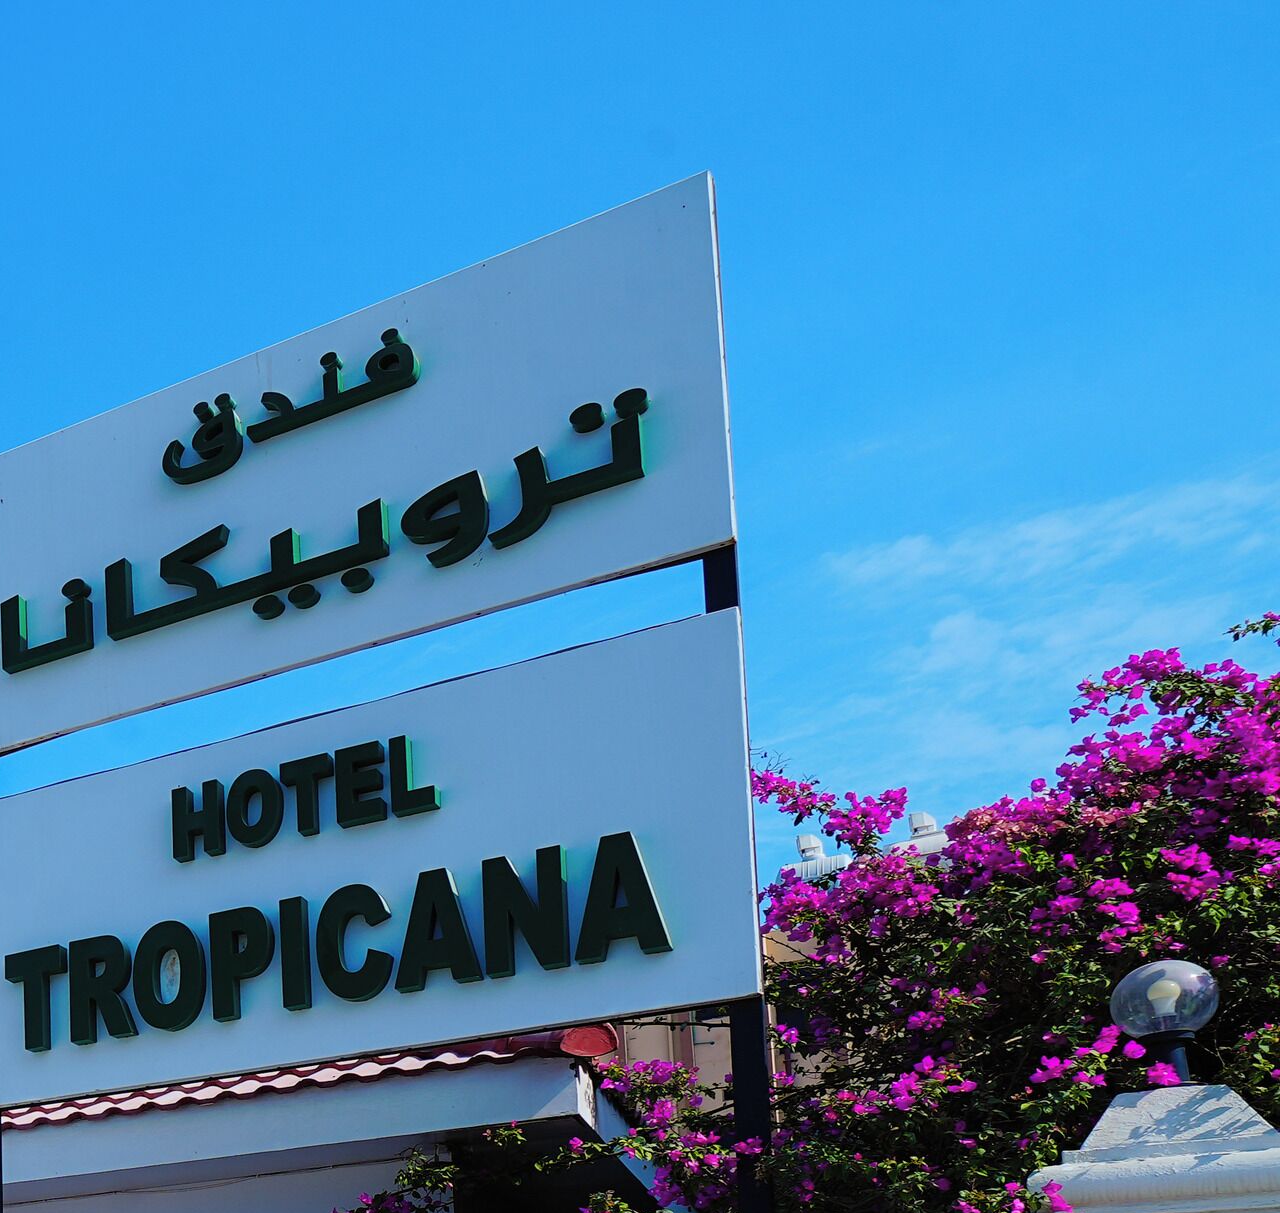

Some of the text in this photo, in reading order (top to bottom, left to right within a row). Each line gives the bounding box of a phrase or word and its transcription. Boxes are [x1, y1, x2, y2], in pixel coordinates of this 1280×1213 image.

[161, 328, 421, 485] فندق
[0, 387, 650, 675] تروبيكانا
[172, 735, 441, 863] HOTEL
[4, 830, 673, 1053] TROPICANA
